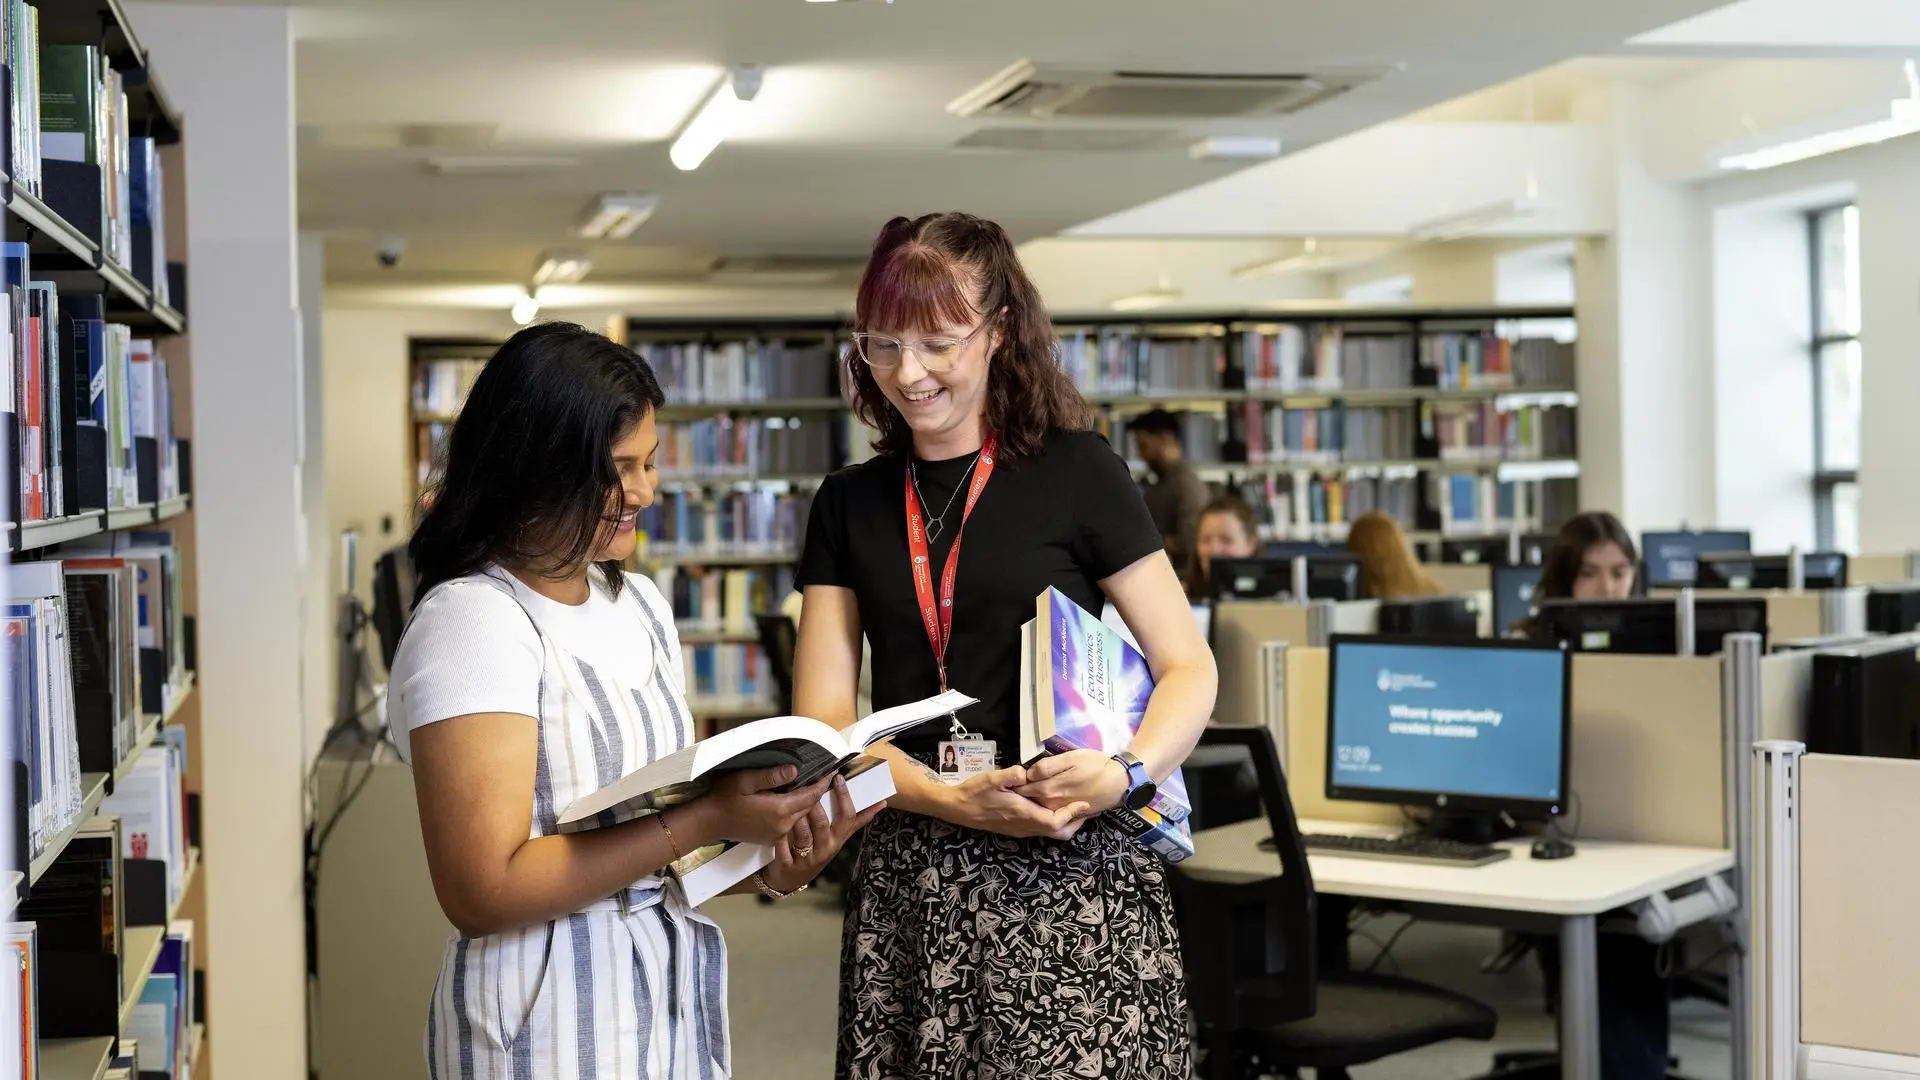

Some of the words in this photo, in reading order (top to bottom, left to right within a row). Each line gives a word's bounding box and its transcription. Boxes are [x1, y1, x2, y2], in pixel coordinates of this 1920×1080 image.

[911, 513, 921, 543] Student
[925, 606, 937, 642] Student
[1086, 632, 1095, 700] Economics
[1096, 631, 1104, 685] Business
[1096, 687, 1105, 706] for
